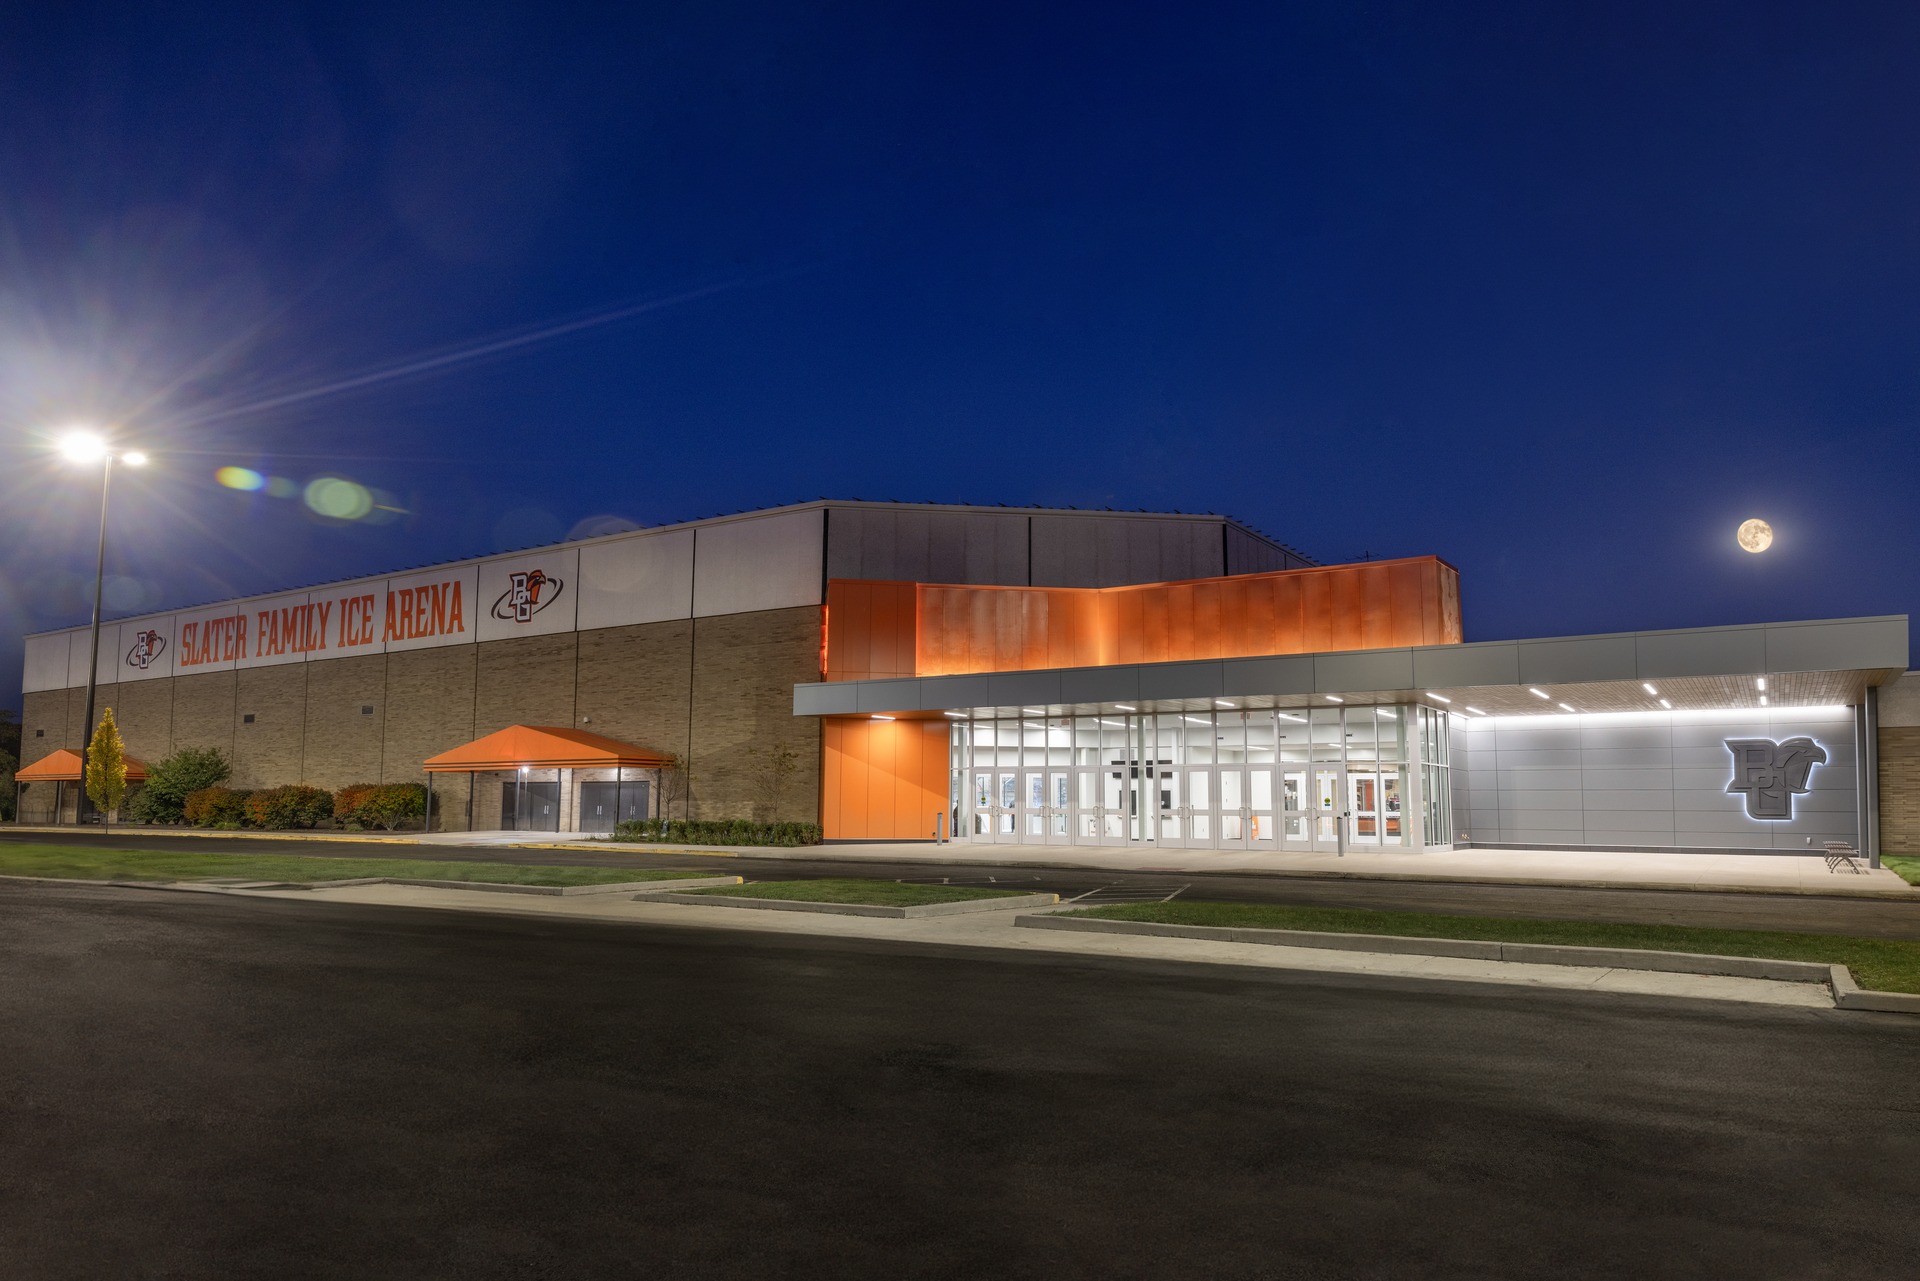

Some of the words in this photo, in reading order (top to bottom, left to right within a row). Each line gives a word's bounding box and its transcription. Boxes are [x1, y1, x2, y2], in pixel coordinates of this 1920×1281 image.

[181, 614, 248, 667] SLATER
[256, 601, 332, 657] FAMILY
[338, 594, 375, 648] ICE
[381, 580, 465, 642] ARENA
